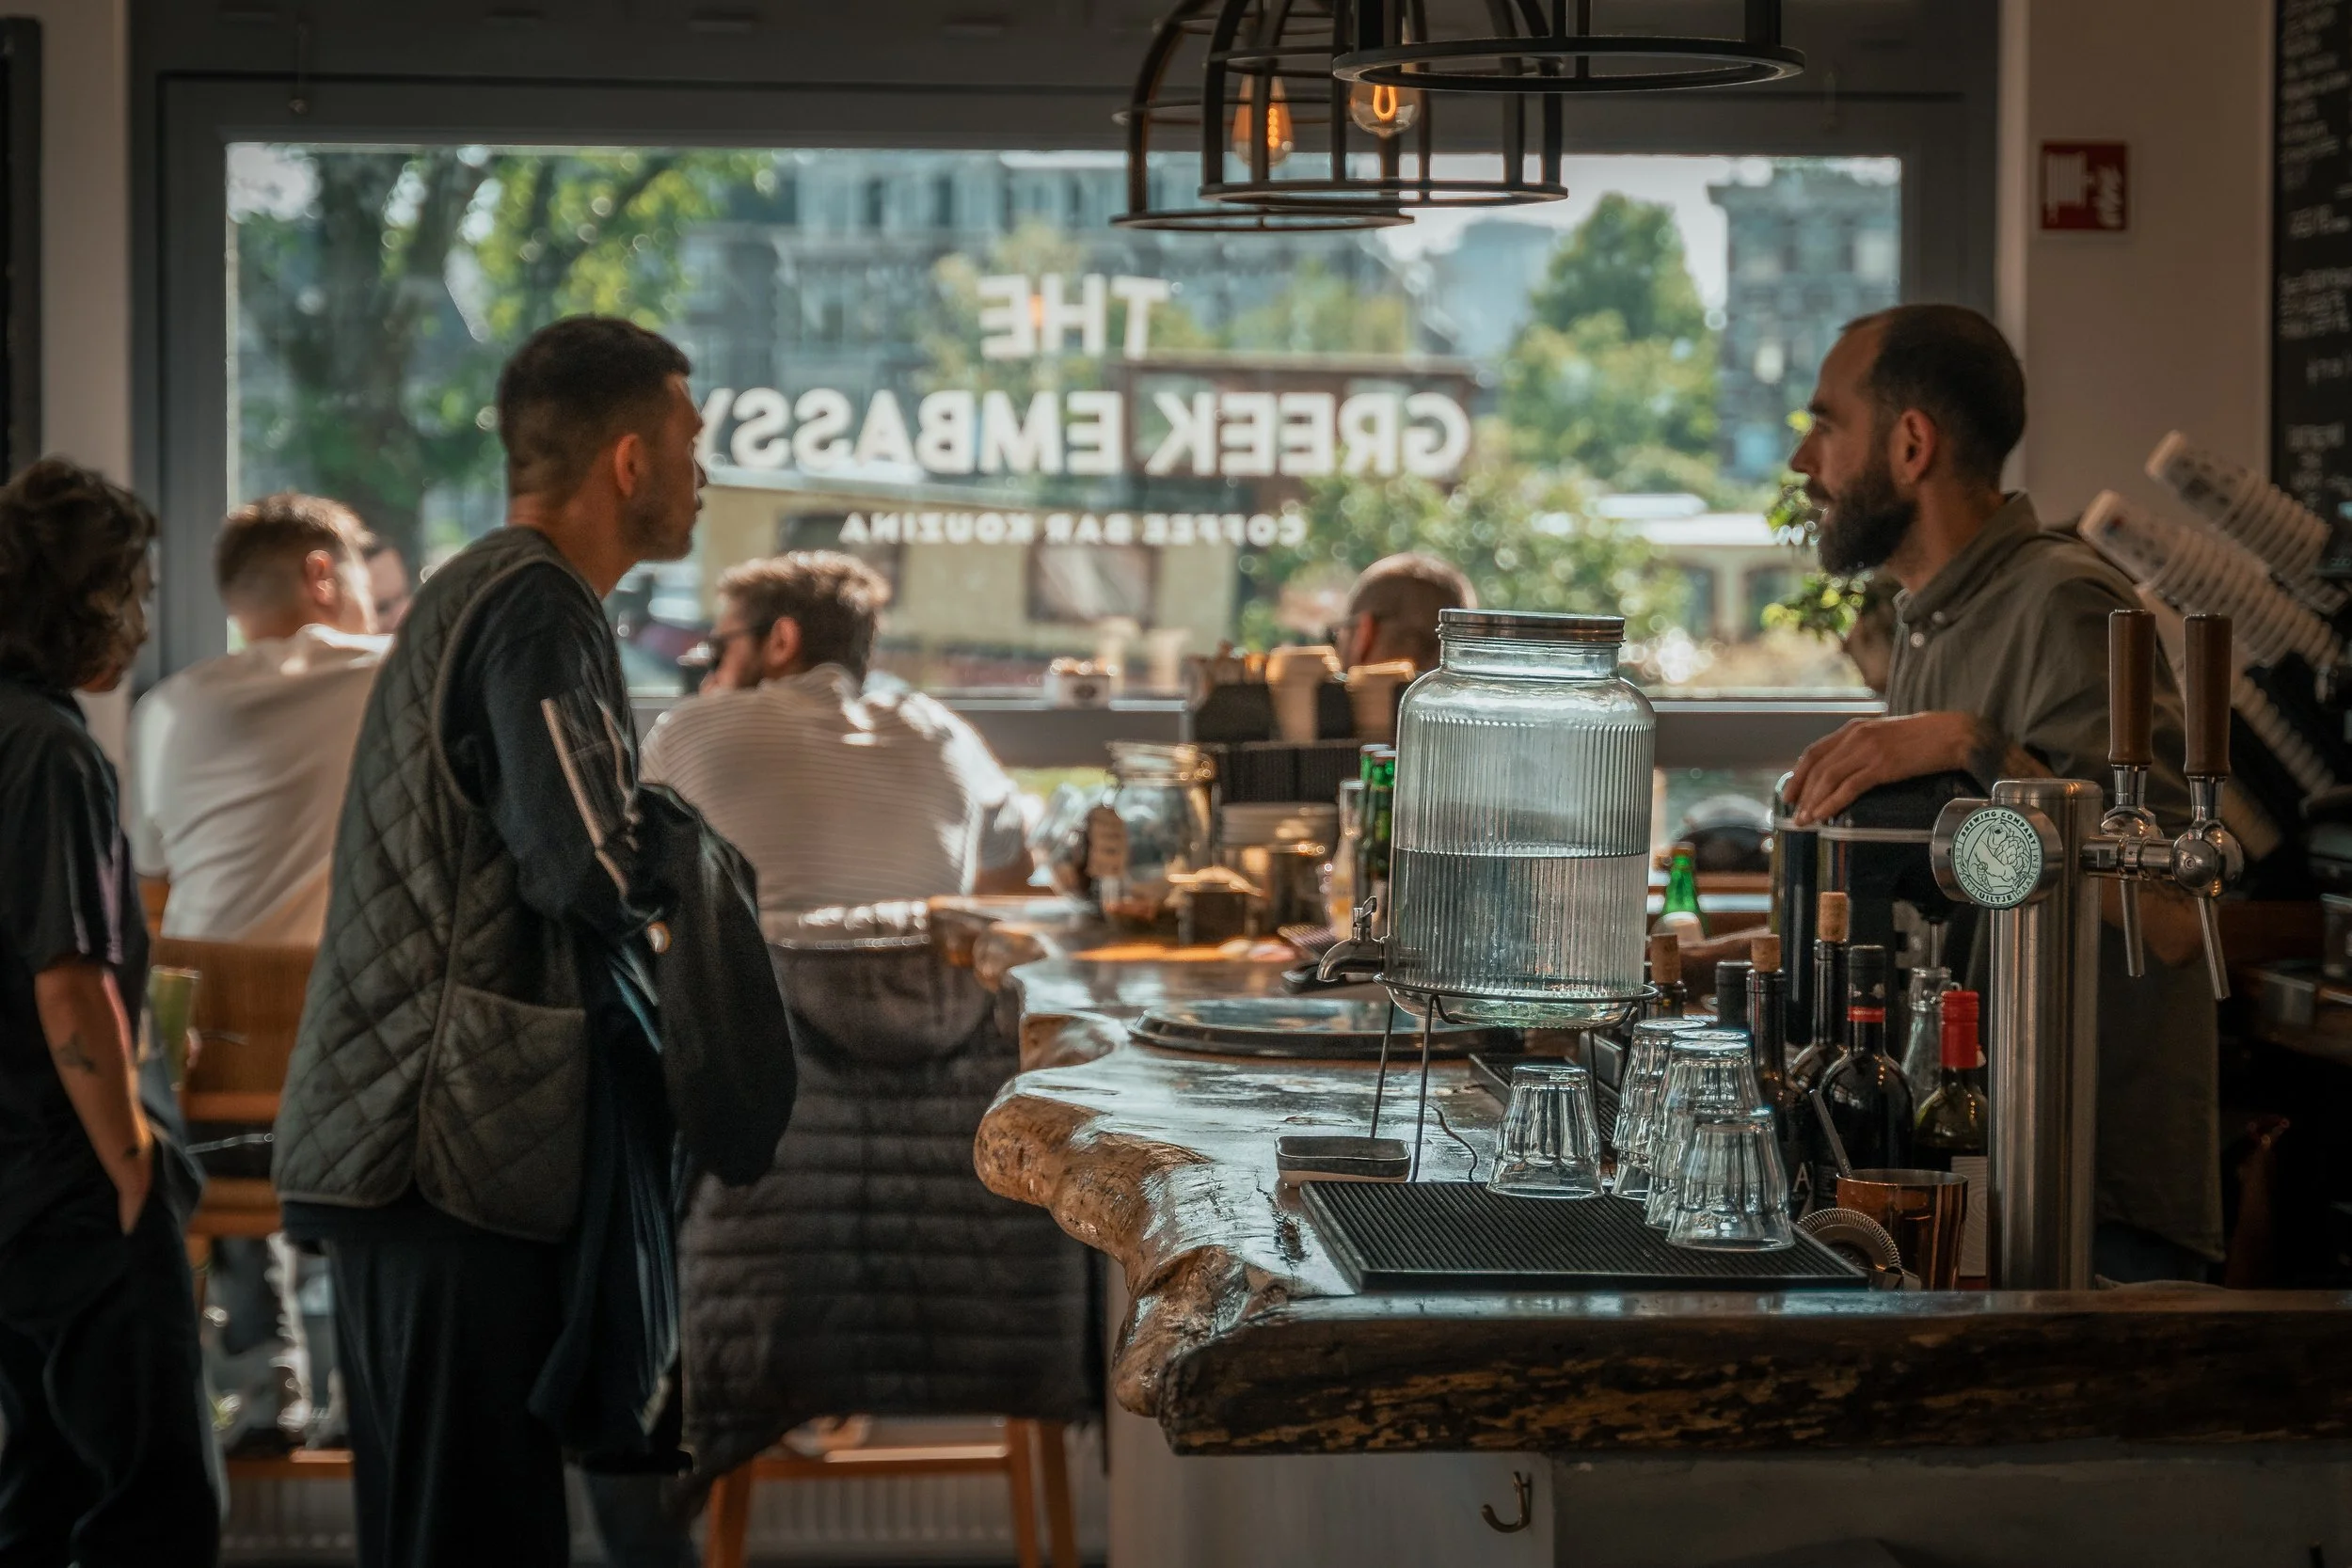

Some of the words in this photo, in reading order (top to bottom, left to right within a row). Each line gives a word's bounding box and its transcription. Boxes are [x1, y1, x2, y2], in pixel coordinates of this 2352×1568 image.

[1962, 811, 1996, 837] BREWING
[2001, 812, 2036, 845] COMPANY
[1959, 872, 1976, 893] 2012
[2016, 854, 2040, 897] HAARLEM
[1979, 893, 2012, 903] UILTJE
